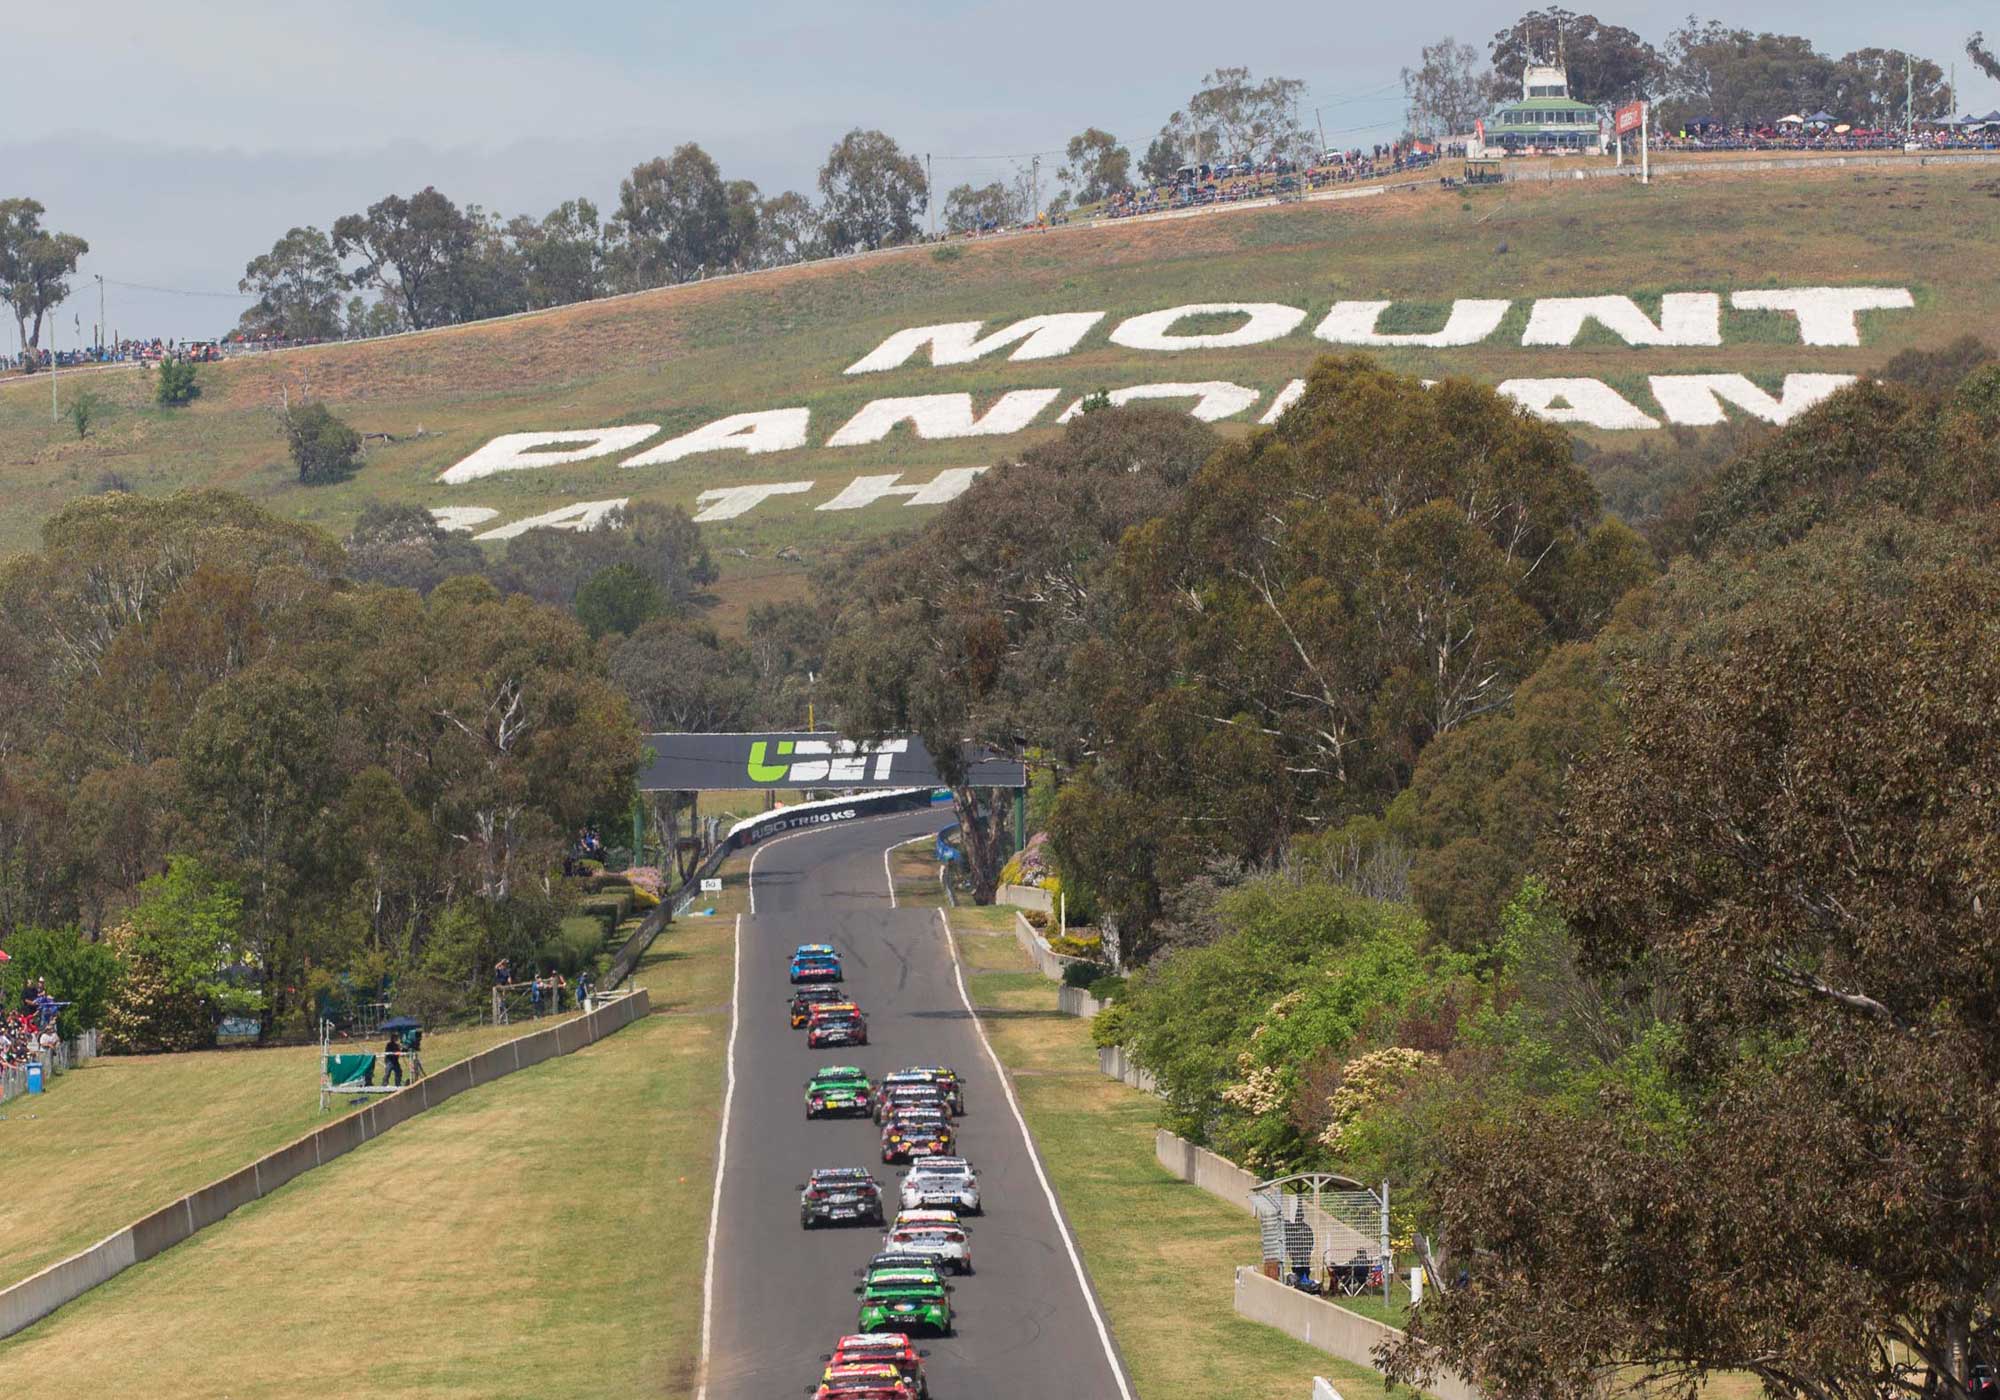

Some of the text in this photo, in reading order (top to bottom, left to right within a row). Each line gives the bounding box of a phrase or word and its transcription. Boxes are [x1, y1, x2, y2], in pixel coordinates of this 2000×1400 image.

[843, 286, 1914, 375] MOUNT
[747, 739, 908, 782] UBET
[789, 809, 857, 828] TRUCKS
